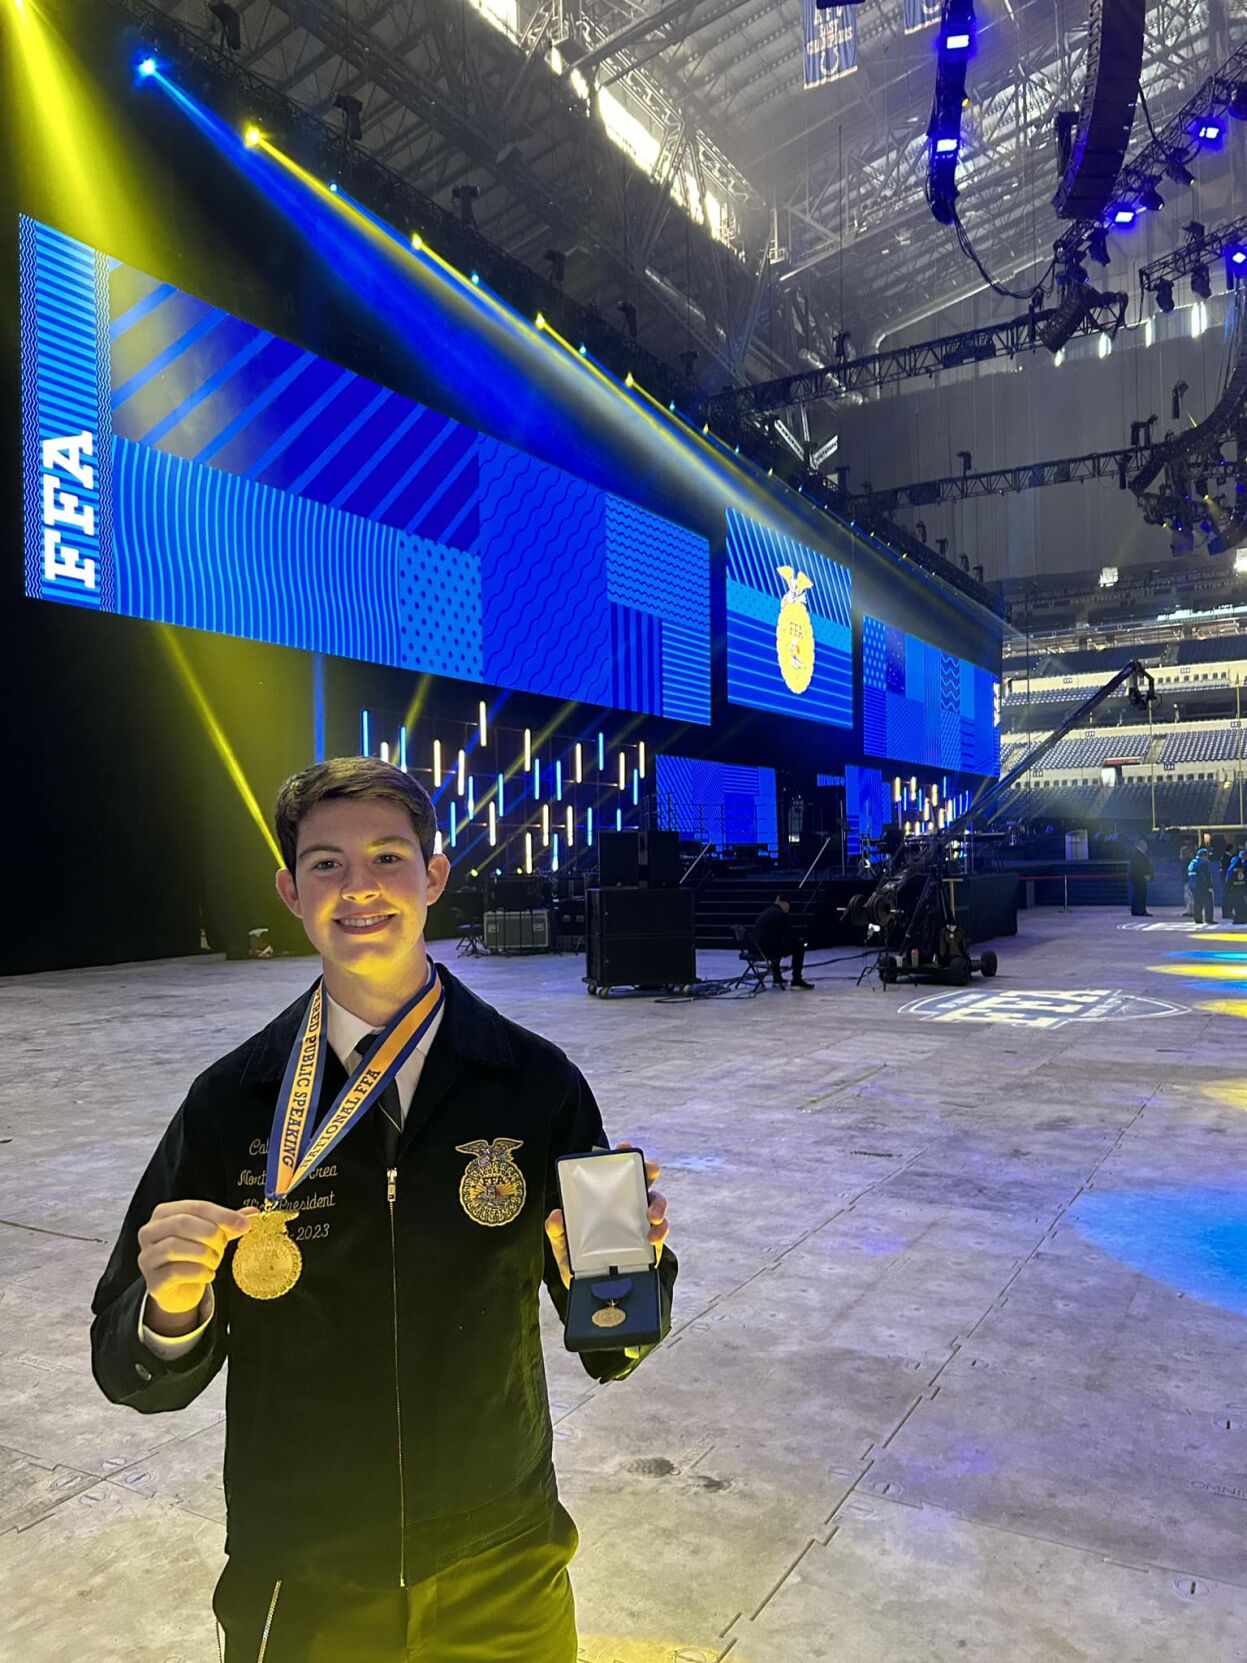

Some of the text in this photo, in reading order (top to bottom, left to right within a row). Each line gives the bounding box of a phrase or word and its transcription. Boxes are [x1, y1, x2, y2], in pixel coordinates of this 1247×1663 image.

[43, 430, 95, 589] FFA
[789, 621, 804, 640] FFA
[296, 1034, 317, 1088] PUBLIC
[282, 1091, 311, 1168] SPEAKING
[301, 1068, 382, 1168] NATIONAL FFA
[248, 1137, 269, 1156] Cal
[237, 1169, 267, 1186] Nort
[482, 1177, 505, 1186] FFA
